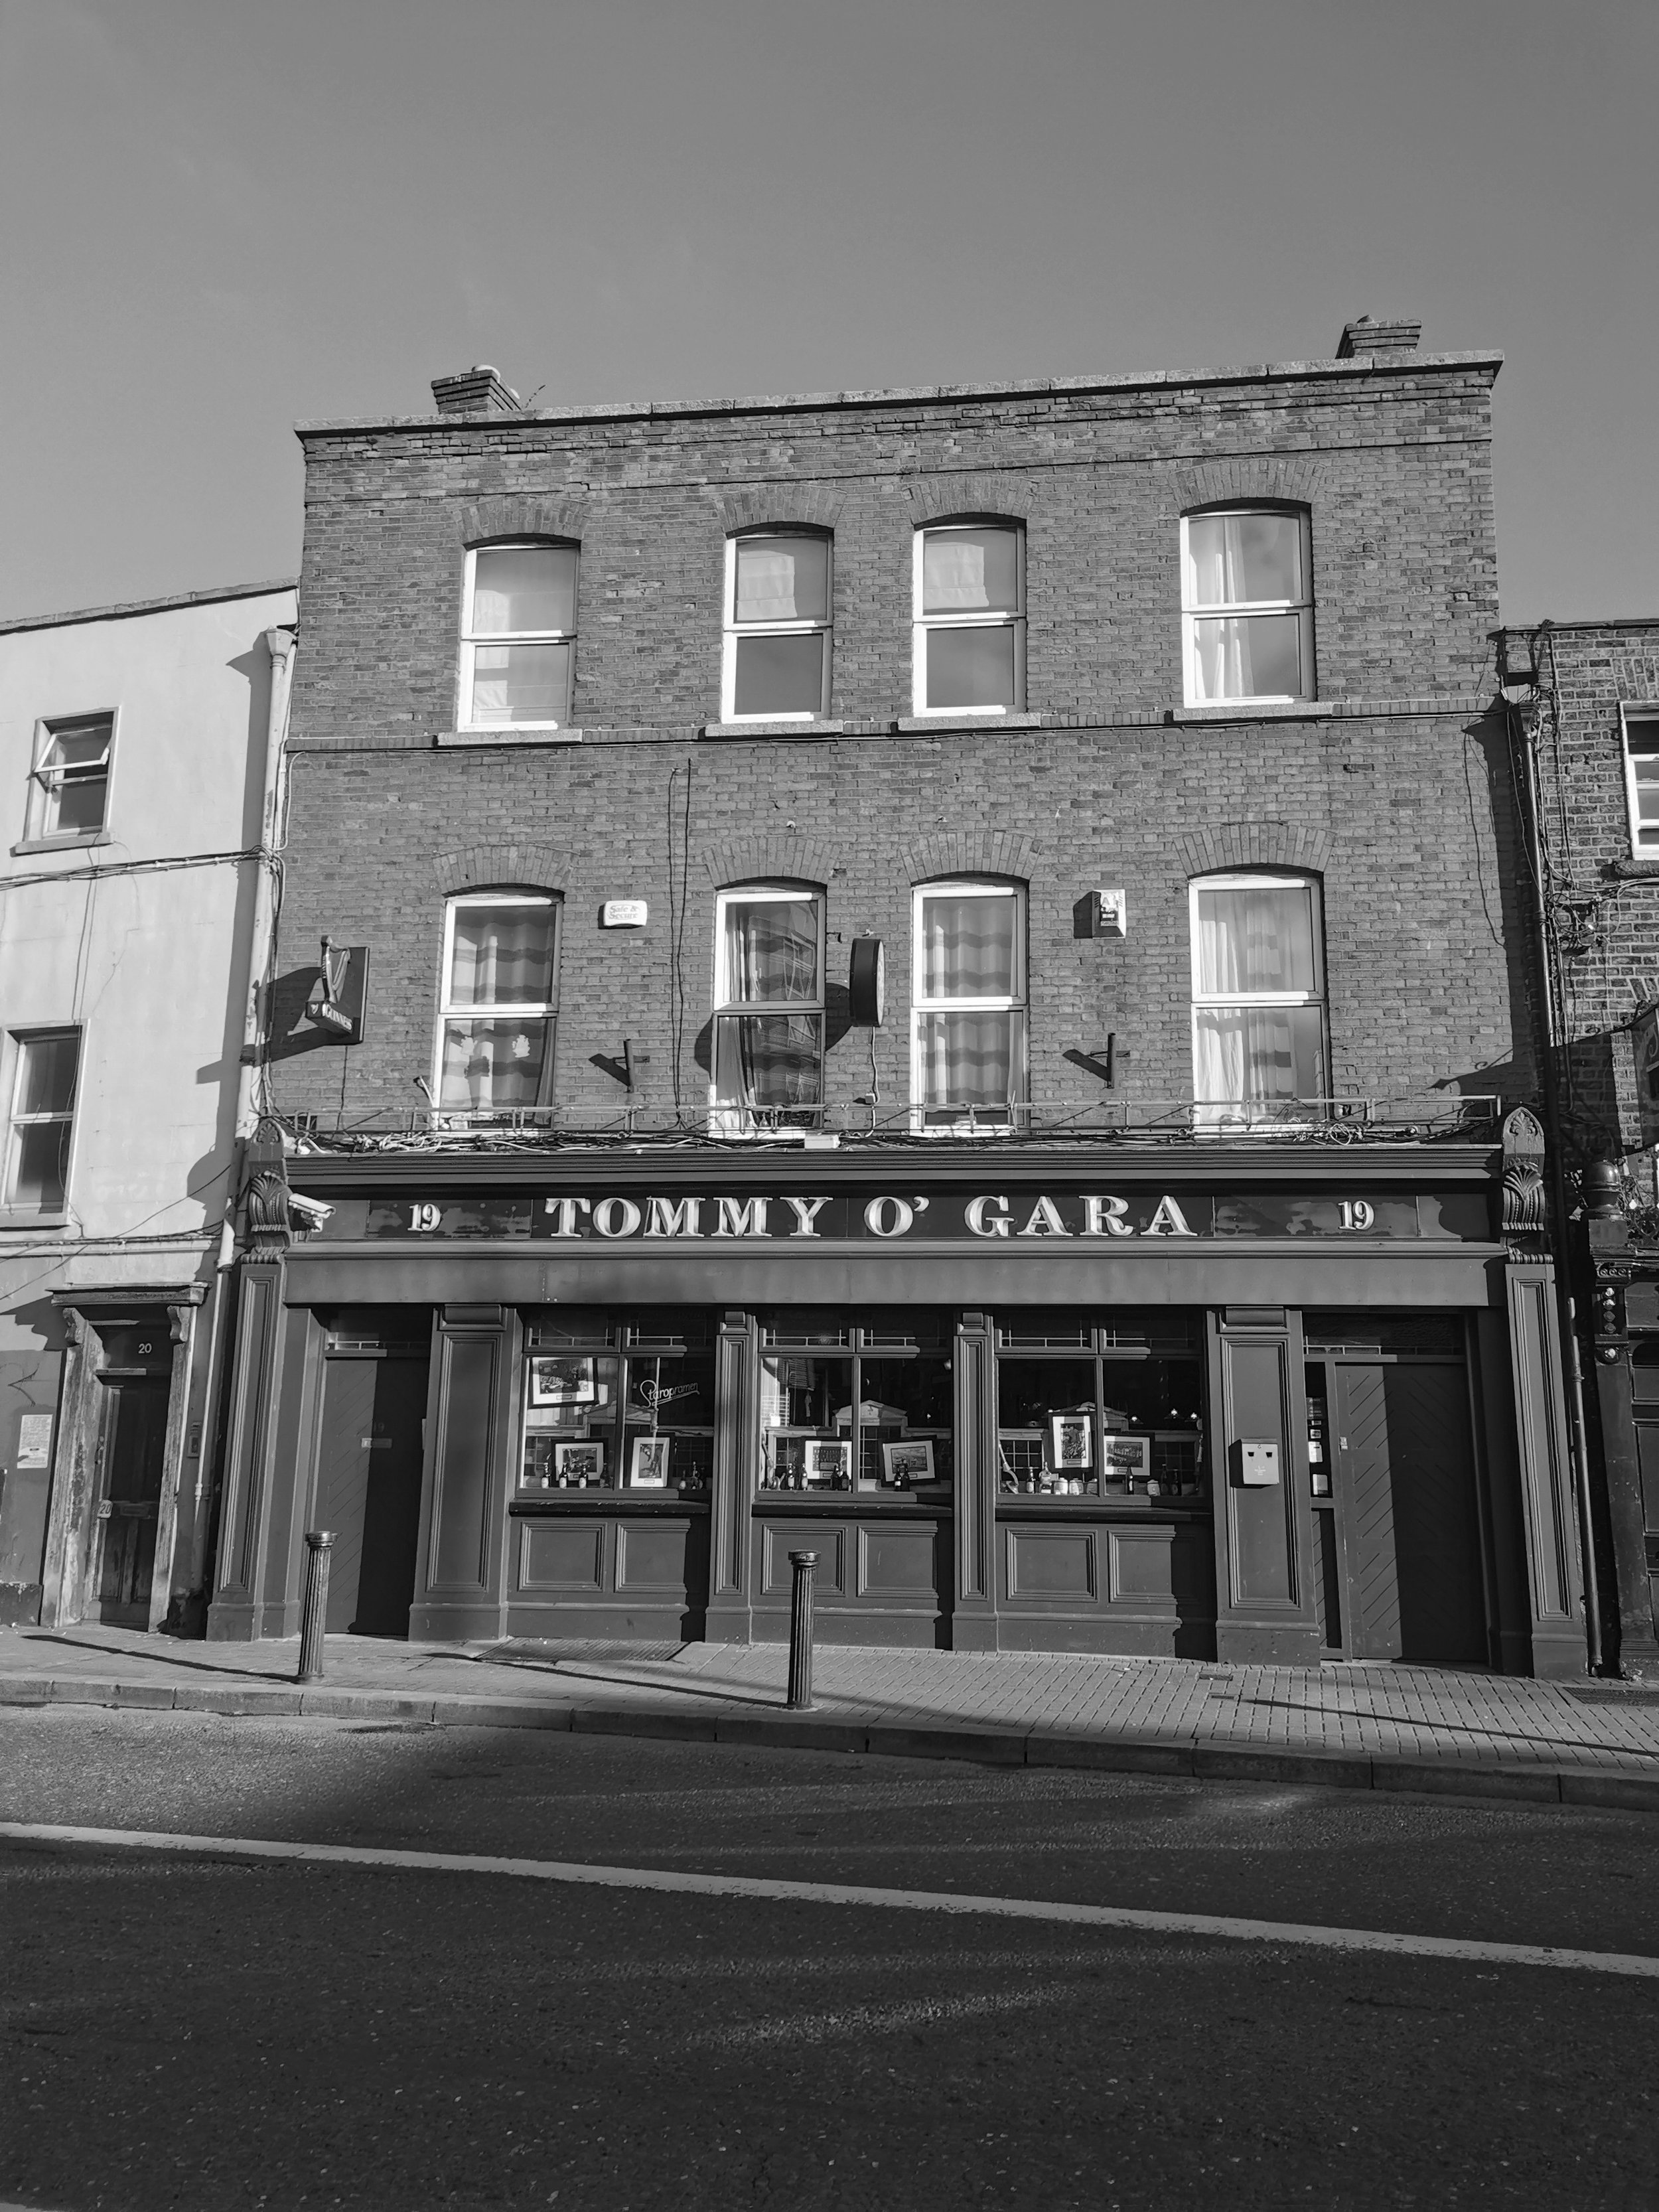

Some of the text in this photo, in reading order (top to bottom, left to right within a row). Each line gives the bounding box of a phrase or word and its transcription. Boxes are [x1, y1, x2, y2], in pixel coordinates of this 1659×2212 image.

[407, 1204, 441, 1231] 19
[545, 1197, 833, 1237] TOMMY
[964, 1195, 1198, 1236] GARA
[1338, 1201, 1374, 1230] 19
[138, 1343, 152, 1353] 20
[640, 1380, 699, 1408] Staropramen
[100, 1504, 111, 1514] 20
